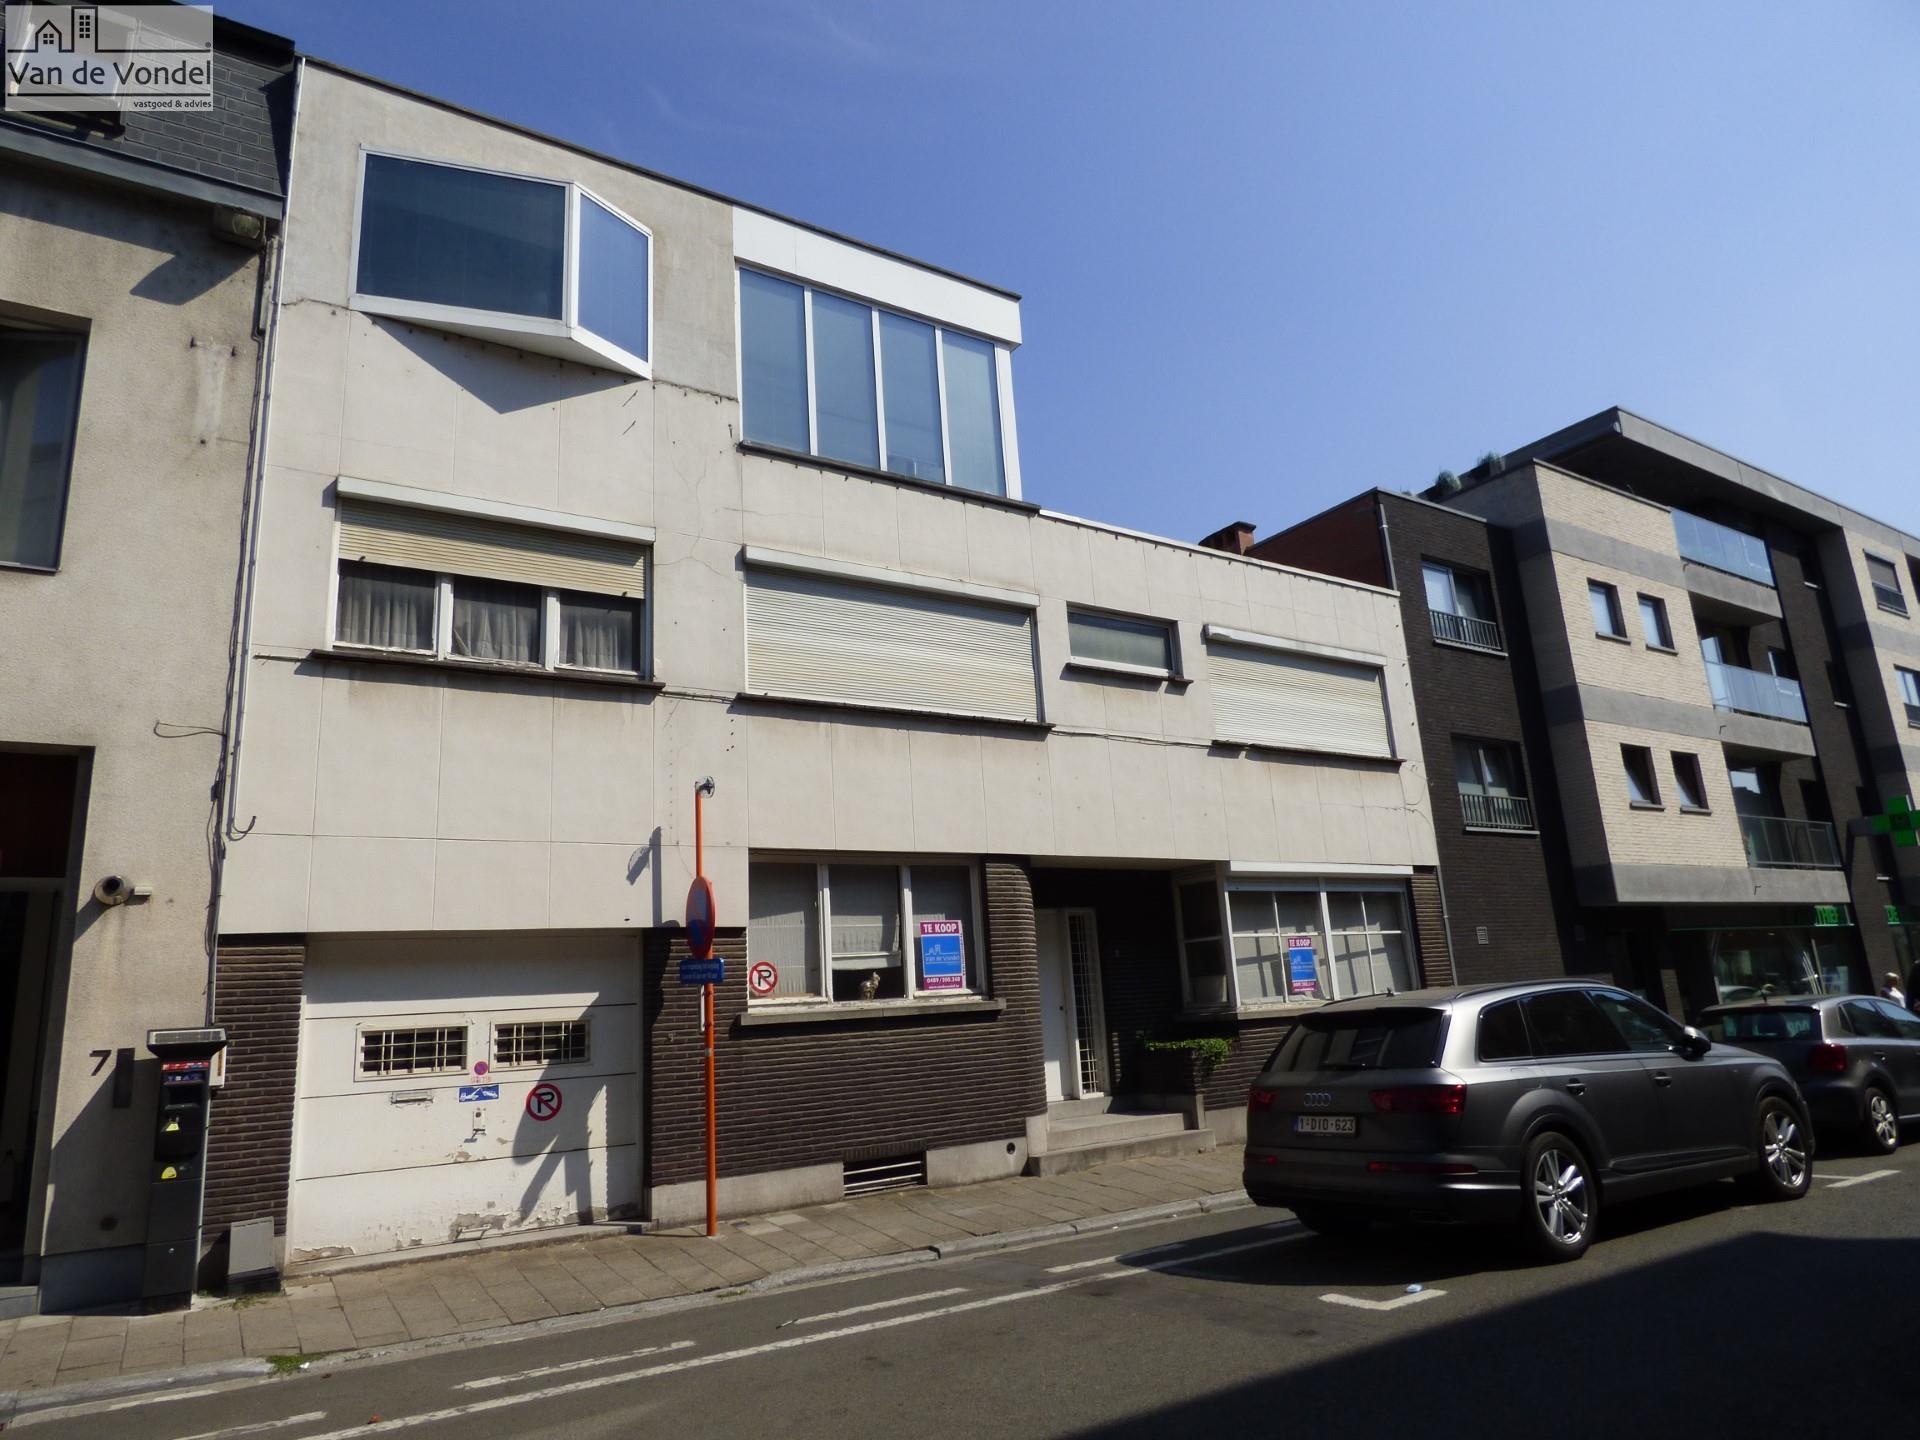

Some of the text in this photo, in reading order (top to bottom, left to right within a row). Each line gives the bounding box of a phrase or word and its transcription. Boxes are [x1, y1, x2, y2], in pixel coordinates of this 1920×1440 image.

[923, 923, 957, 933] TE KOOP
[1289, 939, 1296, 947] TE
[89, 1049, 112, 1077] 7
